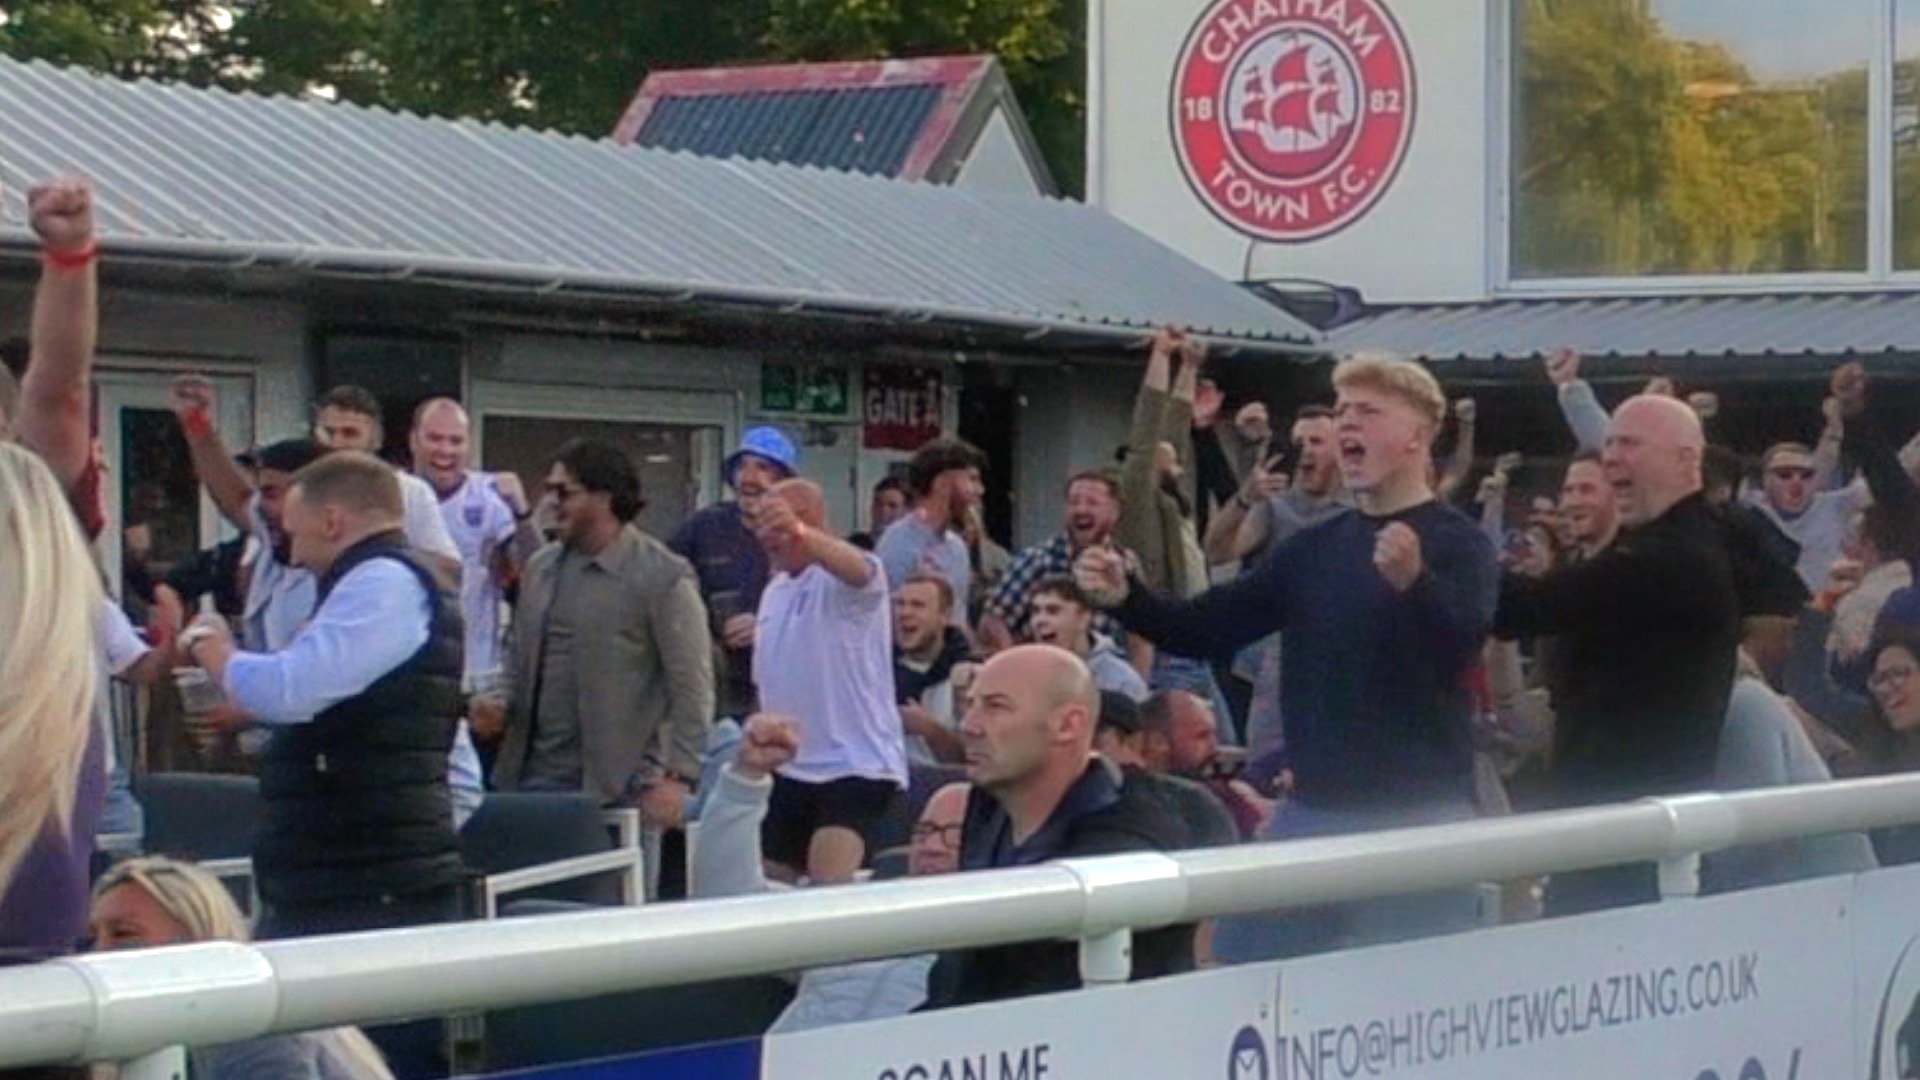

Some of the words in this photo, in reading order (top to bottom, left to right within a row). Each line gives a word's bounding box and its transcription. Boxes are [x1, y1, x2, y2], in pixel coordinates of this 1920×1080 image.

[1184, 97, 1213, 121] 18
[1370, 89, 1400, 114] 82
[1211, 159, 1309, 223] TOWN
[1321, 165, 1376, 212] F.C.
[866, 386, 920, 426] GATE
[1278, 952, 1760, 1080] INFO@HIGHVIEWGLAZING.CO.UK
[878, 1053, 987, 1080] AN
[1000, 1044, 1049, 1080] ME
